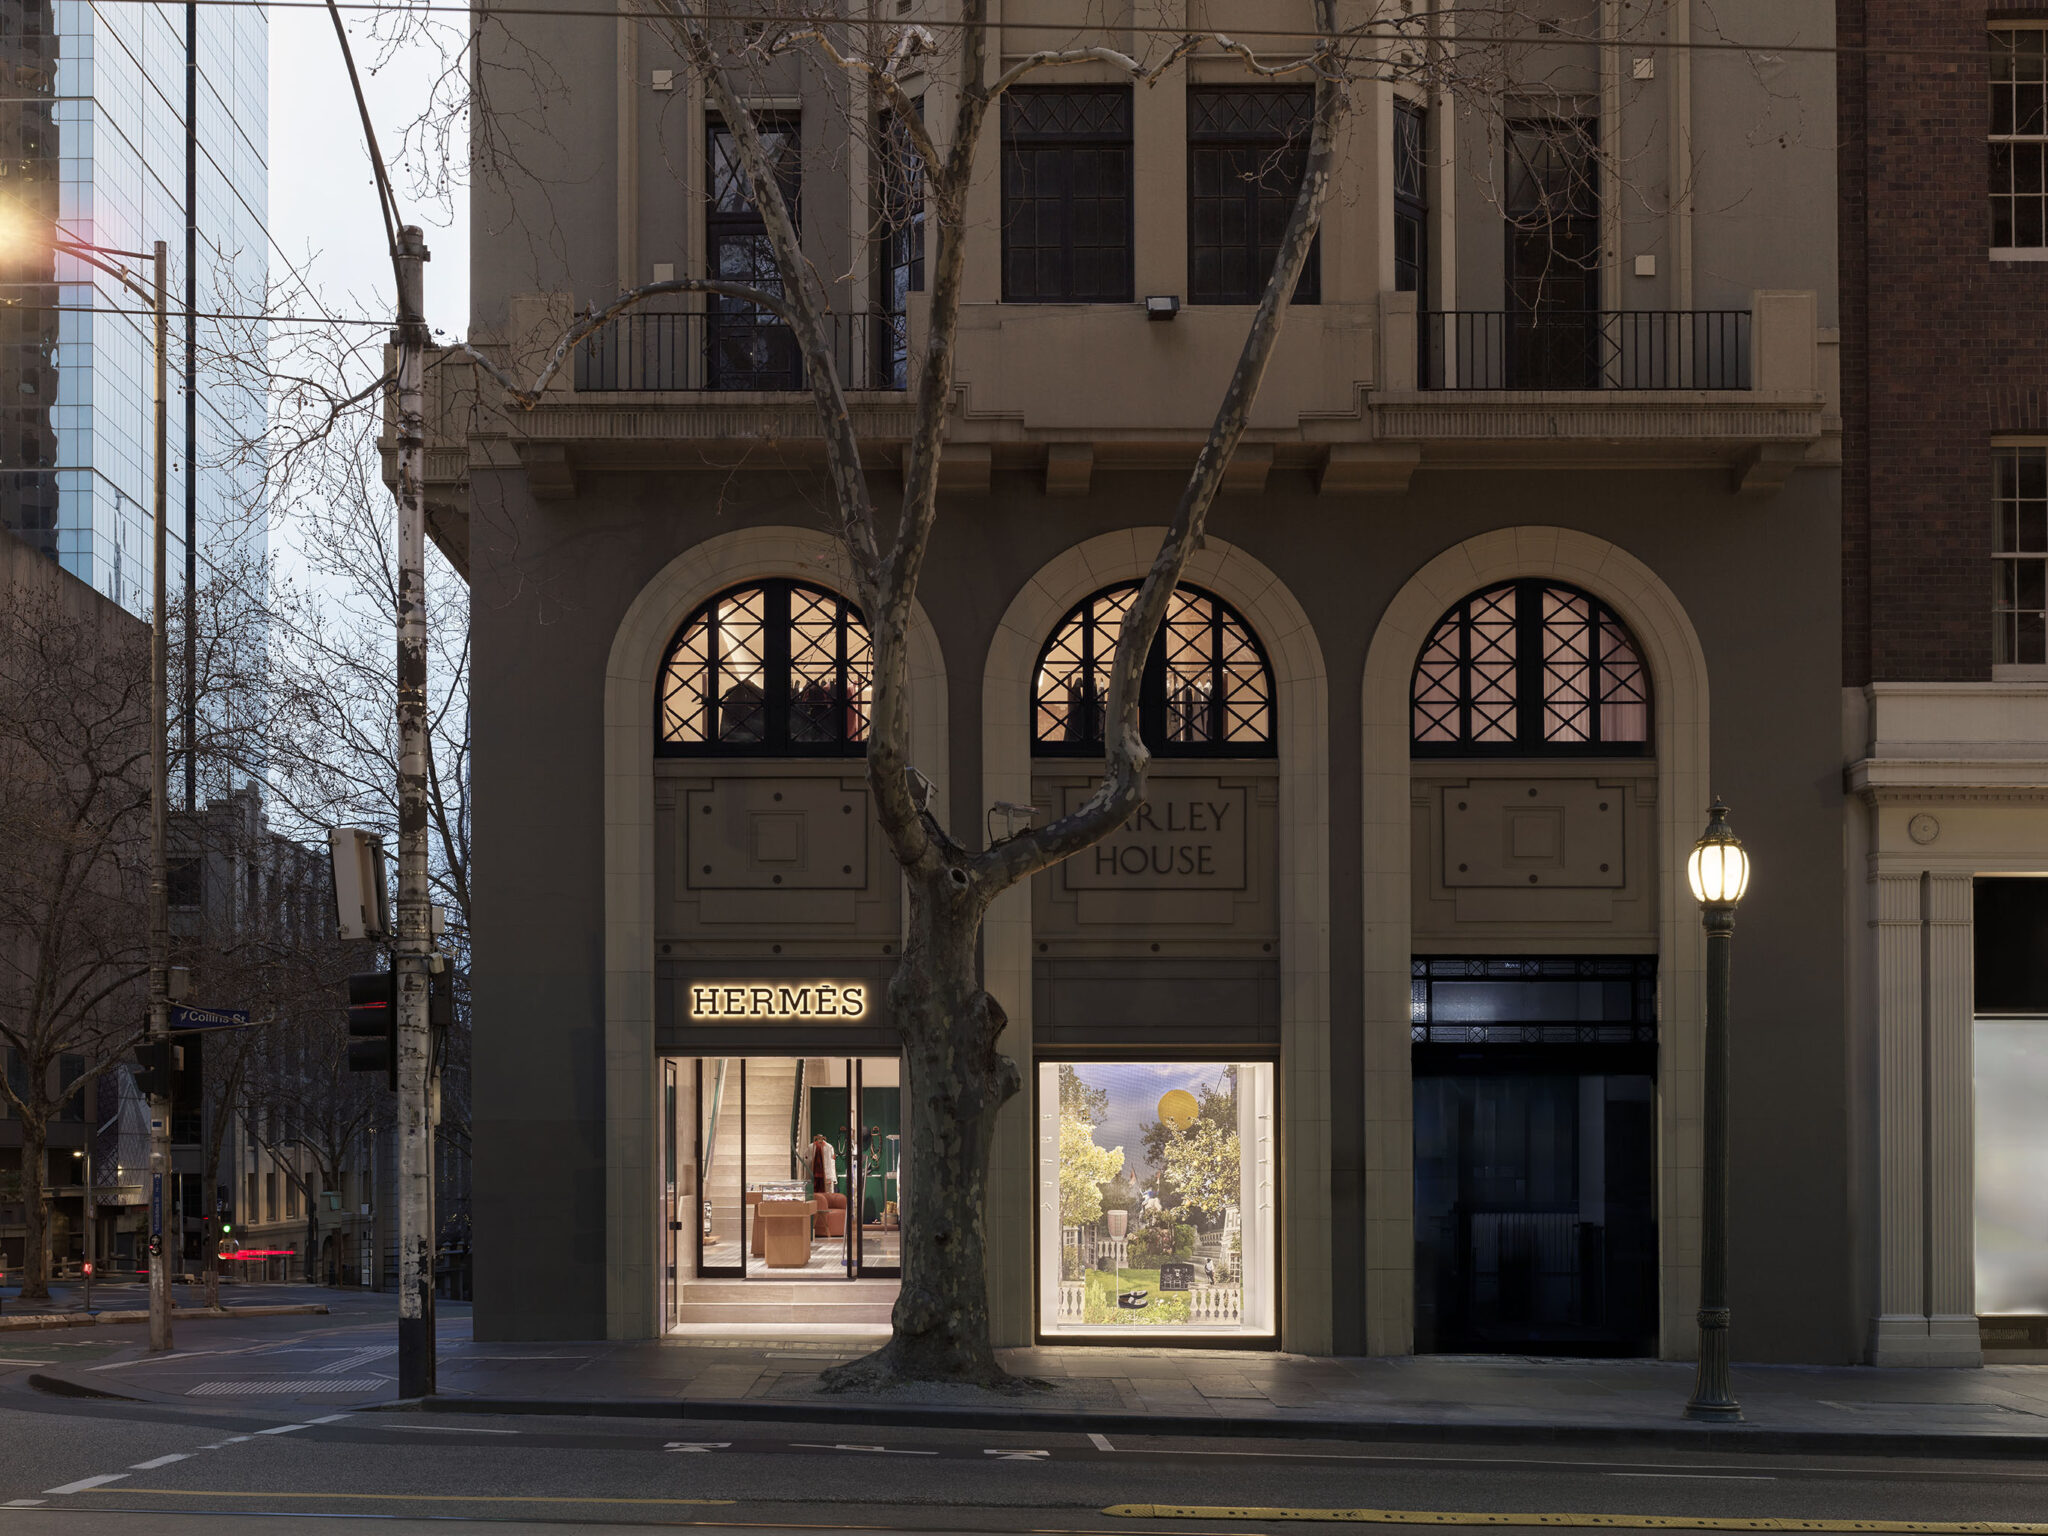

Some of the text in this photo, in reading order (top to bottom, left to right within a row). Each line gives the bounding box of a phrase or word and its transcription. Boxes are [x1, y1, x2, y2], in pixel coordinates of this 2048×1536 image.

[1080, 802, 1230, 831] RLEY
[1095, 845, 1216, 876] HOUSE
[693, 985, 864, 1016] HERMÈS
[189, 1011, 246, 1024] Collins St
